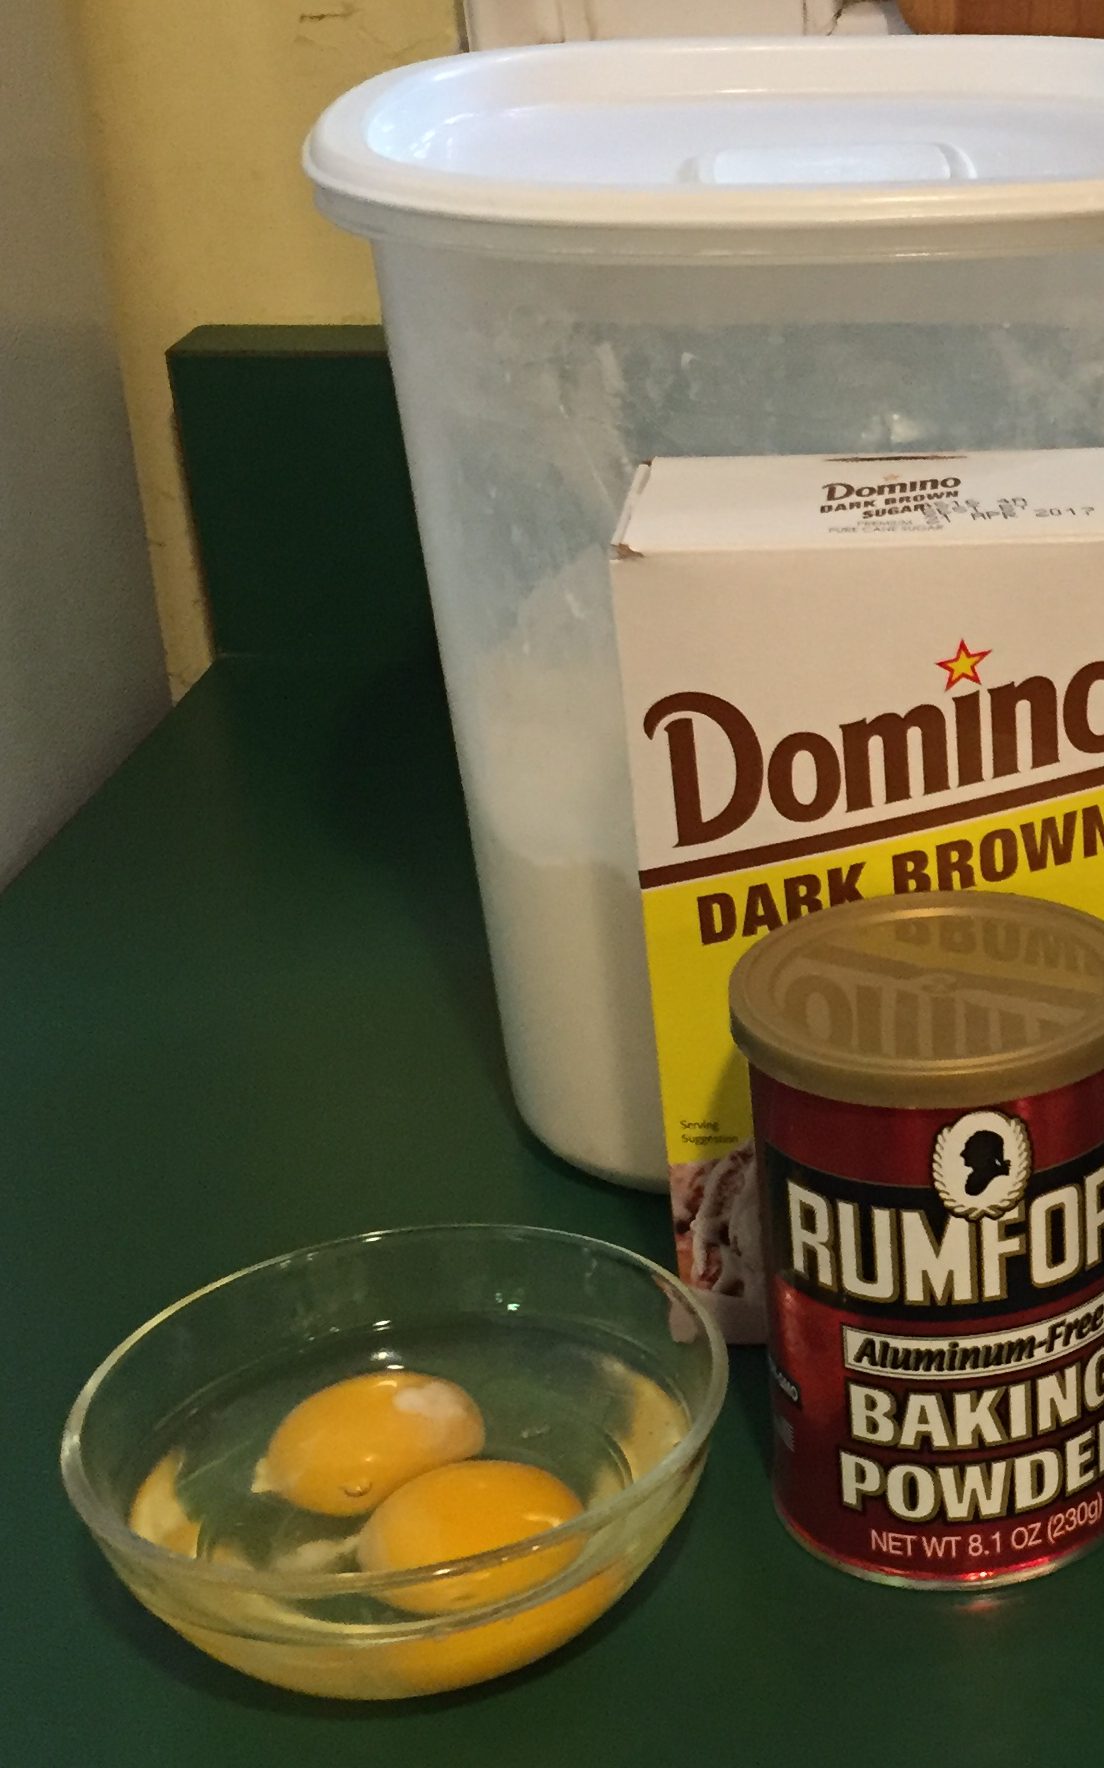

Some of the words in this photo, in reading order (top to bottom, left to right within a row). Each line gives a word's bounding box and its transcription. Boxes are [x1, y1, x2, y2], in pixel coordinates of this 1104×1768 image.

[822, 477, 961, 501] Domino
[820, 500, 876, 514] DARK
[884, 490, 959, 506] BROWN
[862, 503, 926, 519] SUGAR
[1034, 505, 1096, 519] 2017
[696, 861, 866, 946] DARK
[680, 1119, 720, 1132] Serving
[871, 1528, 918, 1557] NET
[921, 1536, 962, 1559] WT
[968, 1530, 1002, 1557] 8.1
[1010, 1523, 1043, 1550] OZ
[1046, 1491, 1104, 1545] (230g)
